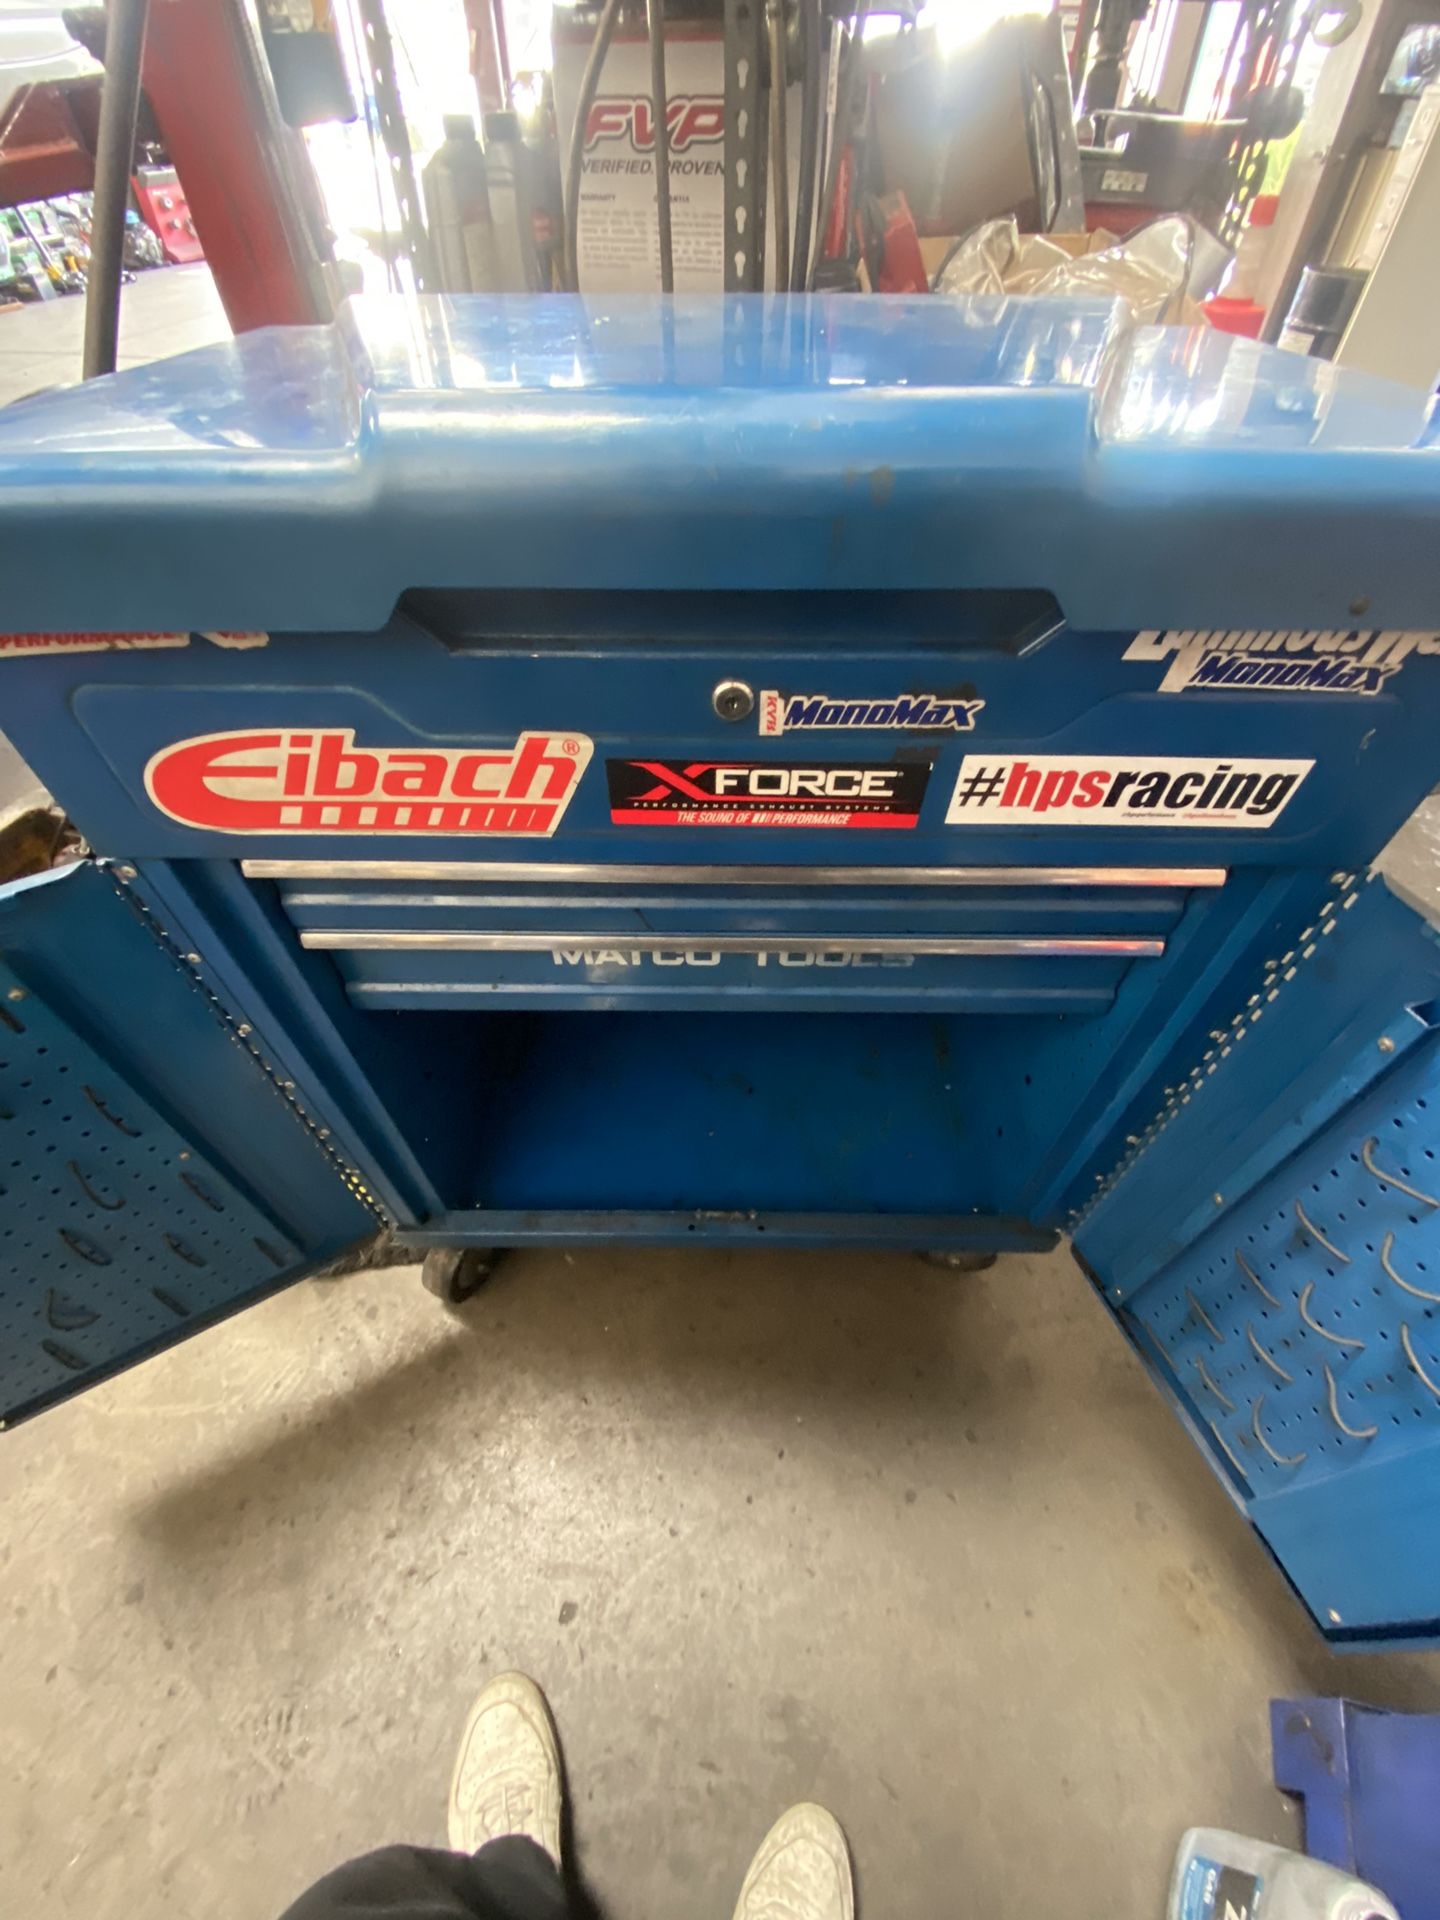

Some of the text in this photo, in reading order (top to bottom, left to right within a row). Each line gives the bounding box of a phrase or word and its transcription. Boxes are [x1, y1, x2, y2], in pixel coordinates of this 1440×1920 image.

[584, 95, 724, 152] FVP
[766, 696, 778, 731] KYB
[152, 733, 577, 830] Eibach
[959, 762, 1301, 816] #hpsracing
[677, 811, 852, 825] THE SOUND OF PERFORMANCE
